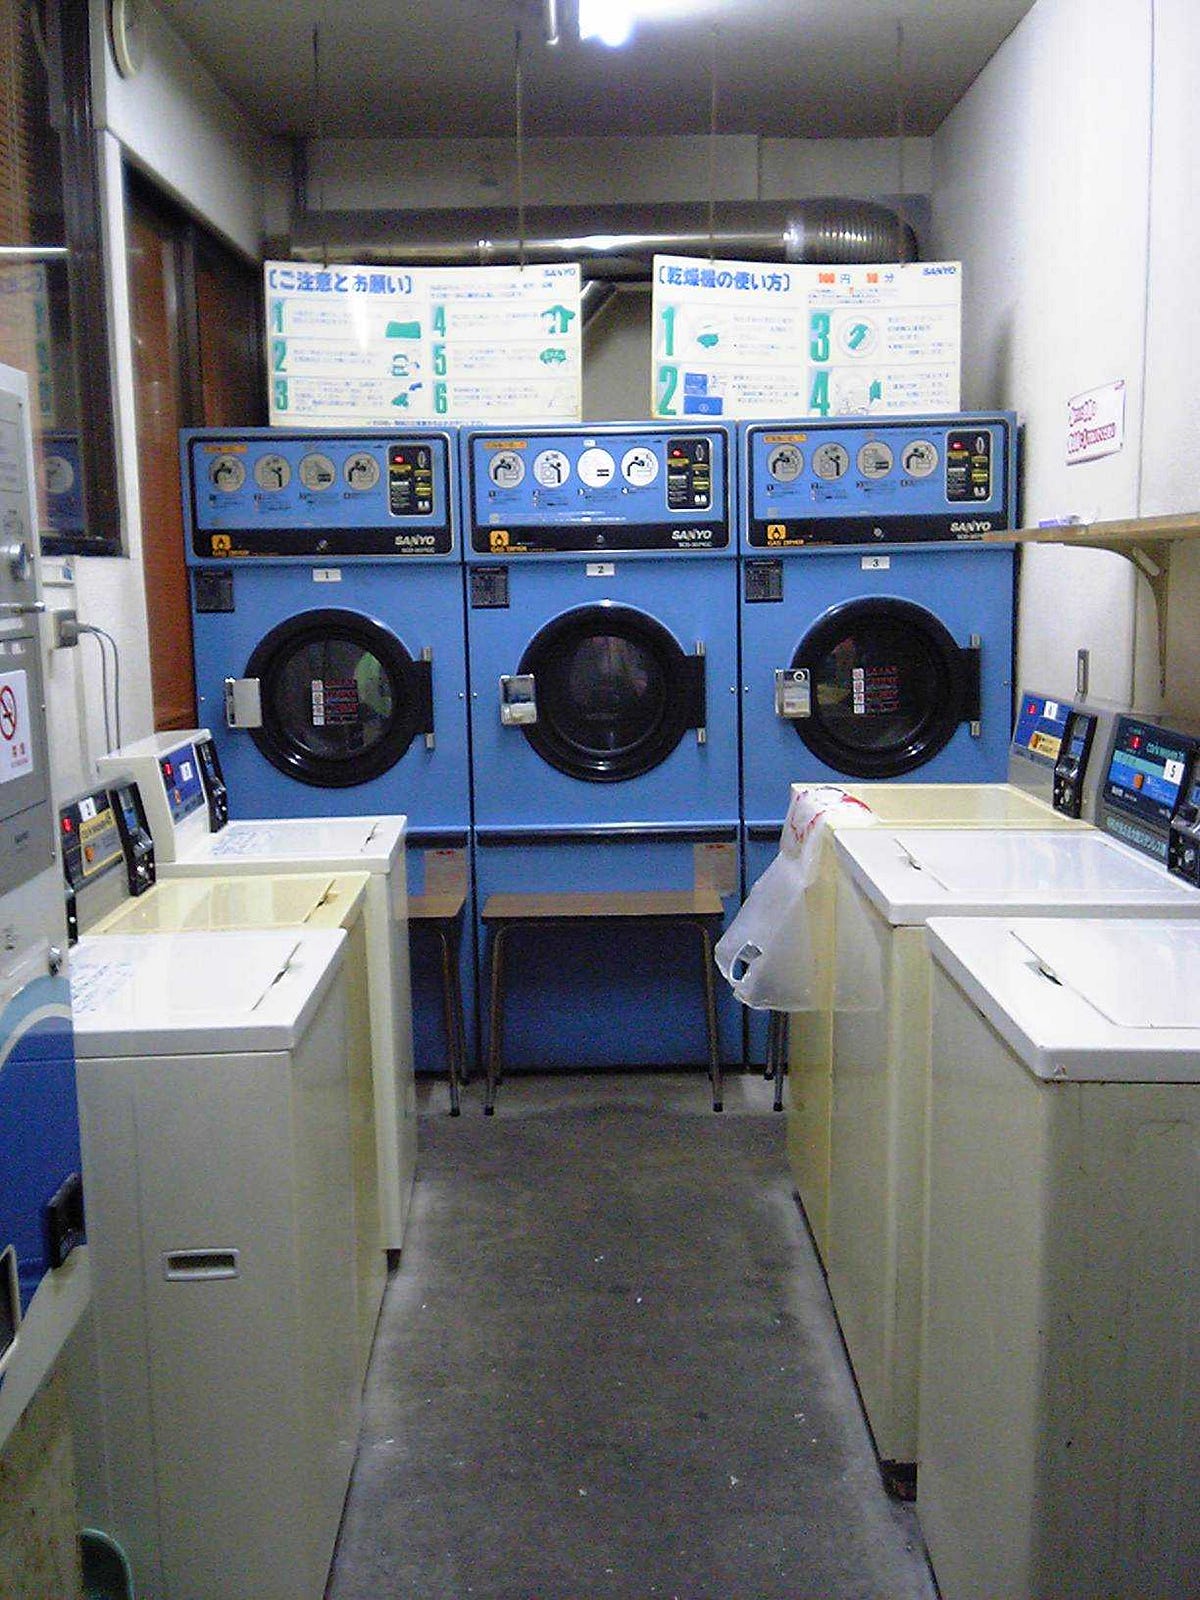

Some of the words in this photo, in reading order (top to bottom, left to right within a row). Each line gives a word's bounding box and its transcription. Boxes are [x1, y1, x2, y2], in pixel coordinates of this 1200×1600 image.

[543, 268, 576, 277] SANYO
[922, 265, 957, 276] SANYO
[273, 301, 285, 333] 1
[433, 305, 447, 338] 4
[661, 306, 675, 356] 1
[810, 313, 831, 362] 3
[273, 341, 288, 373] 2
[434, 344, 447, 376] 5
[274, 380, 288, 411] 3
[434, 382, 448, 415] 6
[660, 366, 678, 415] 2
[810, 372, 831, 416] 4
[394, 535, 435, 546] SANYO
[671, 529, 712, 540] SANYO
[950, 520, 991, 533] SANYO
[597, 565, 604, 574] 2
[872, 558, 880, 568] 3
